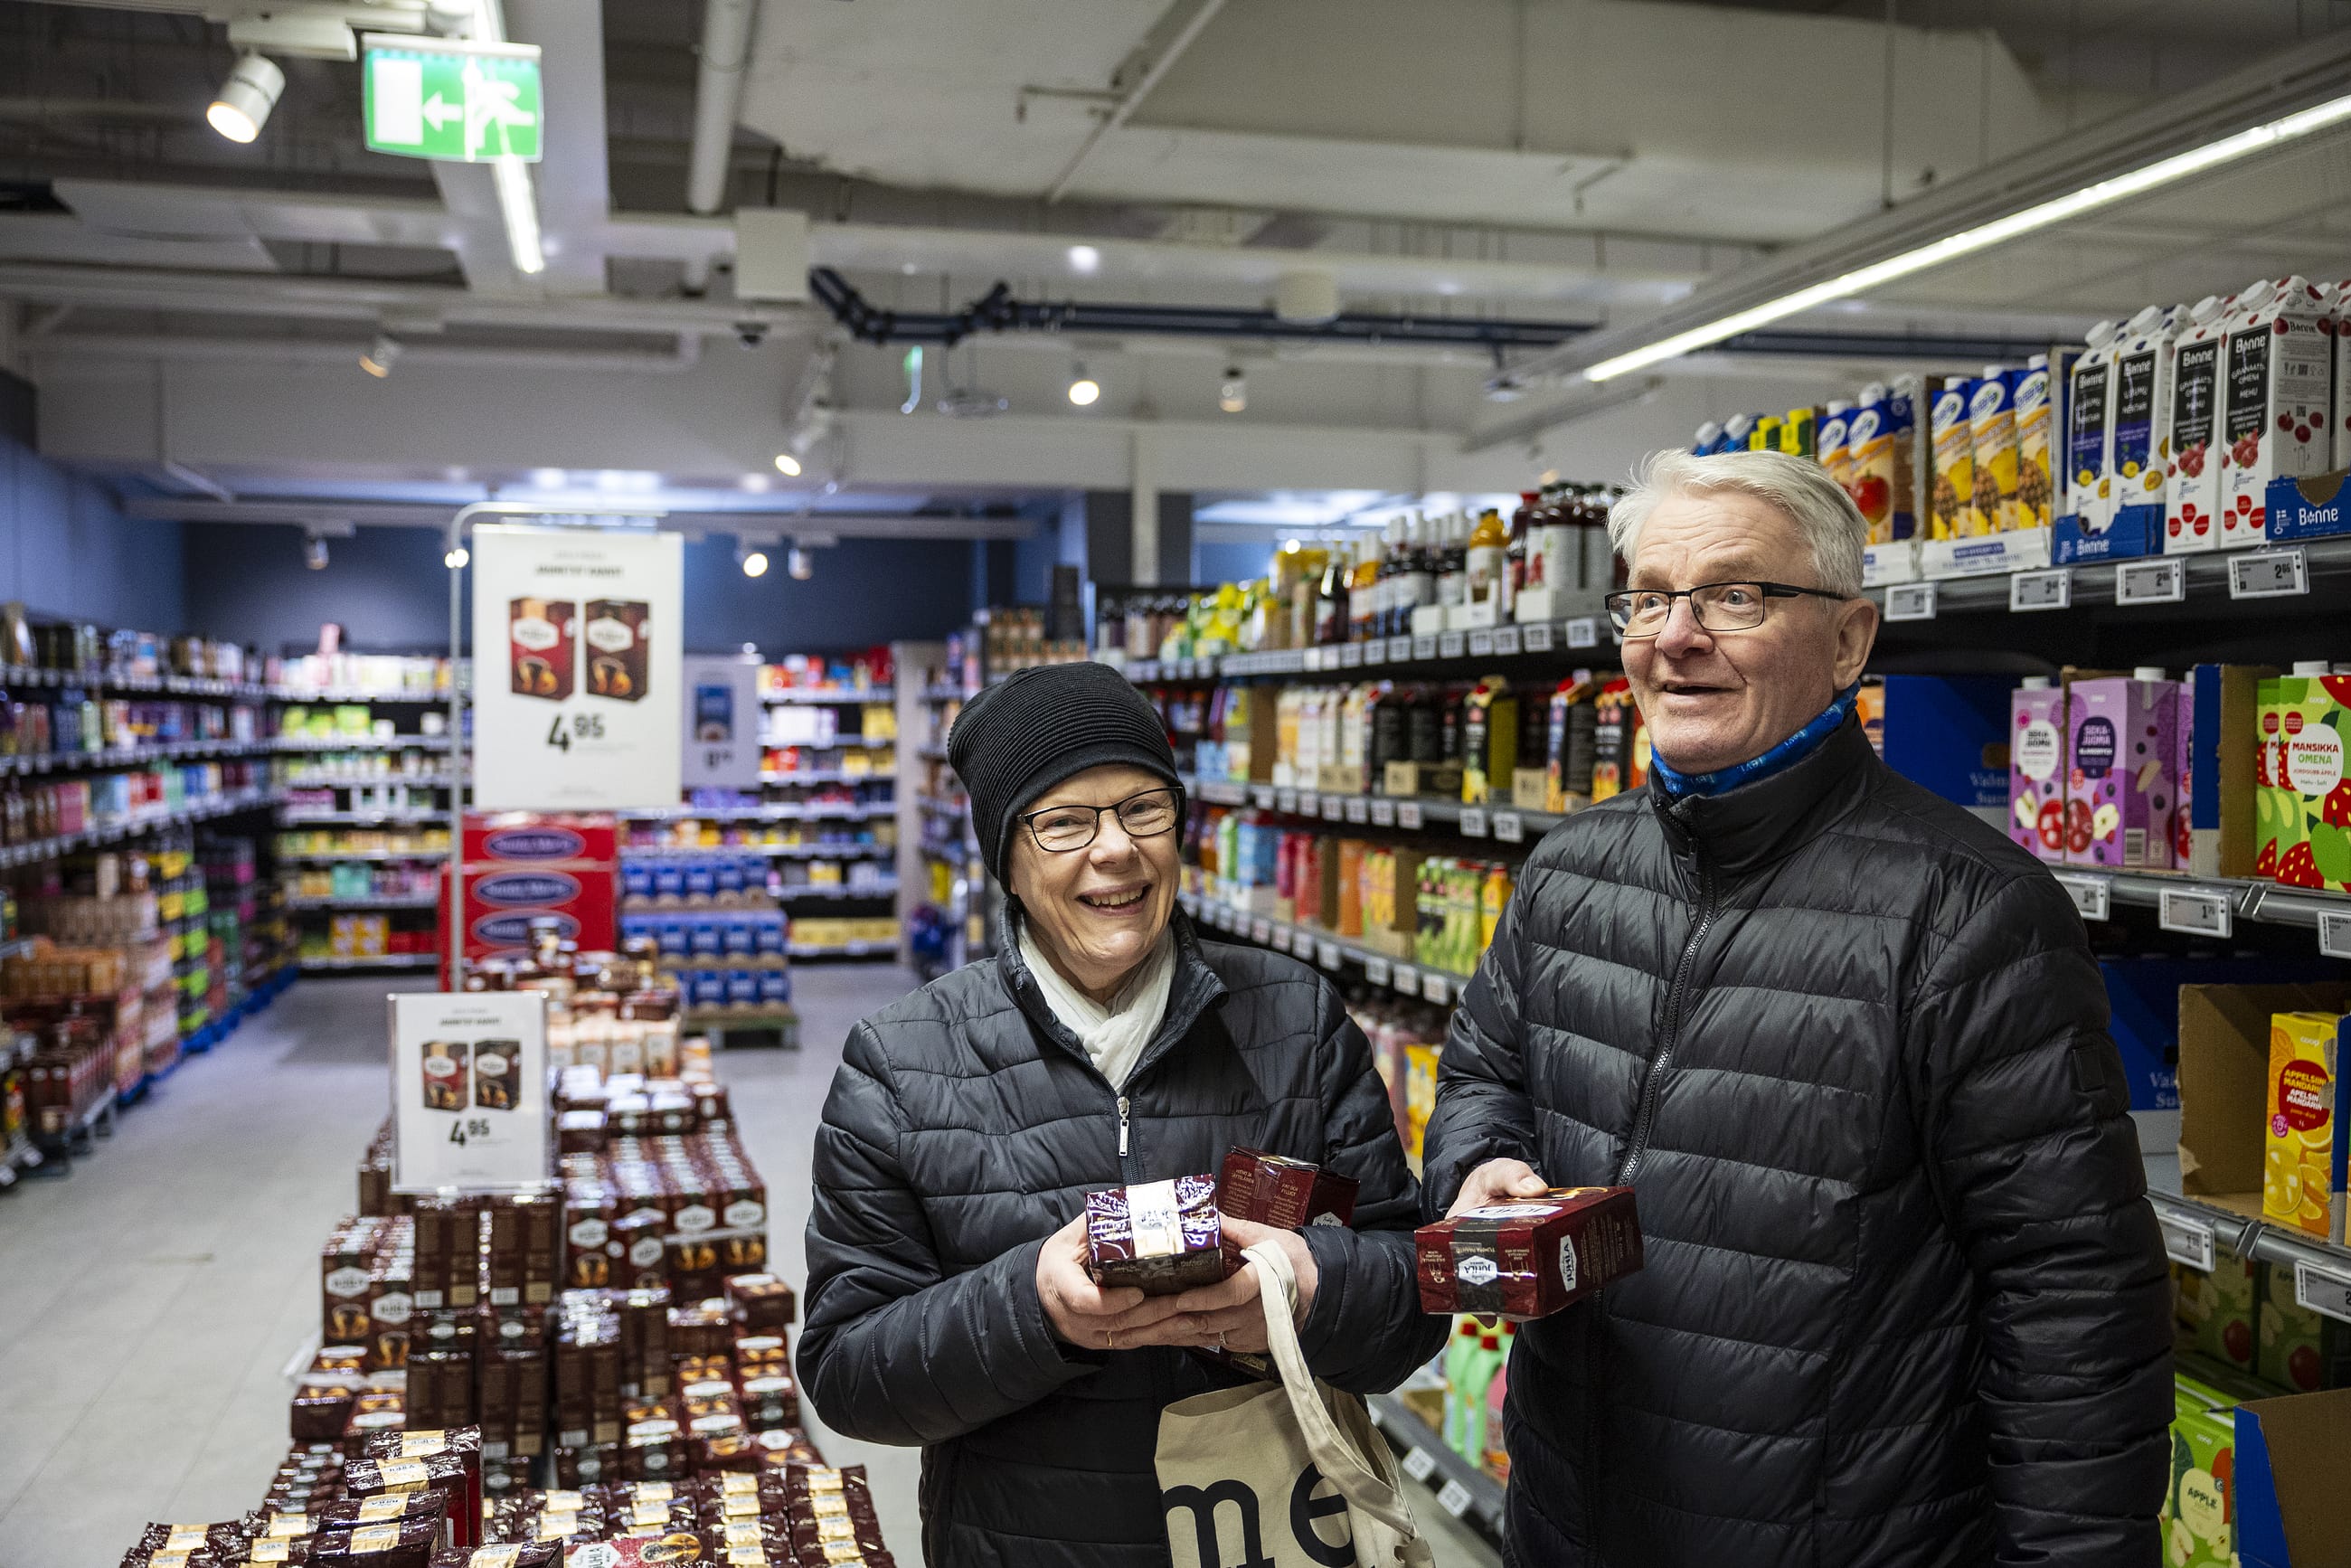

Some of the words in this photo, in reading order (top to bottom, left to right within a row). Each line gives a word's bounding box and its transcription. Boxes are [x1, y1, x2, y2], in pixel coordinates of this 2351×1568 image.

[2299, 507, 2339, 526] Bonne
[2292, 741, 2339, 753] MANSIKKA
[2298, 753, 2333, 764] OMENA
[1563, 1242, 1573, 1283] JUHLA
[1463, 1264, 1492, 1274] JUHLA
